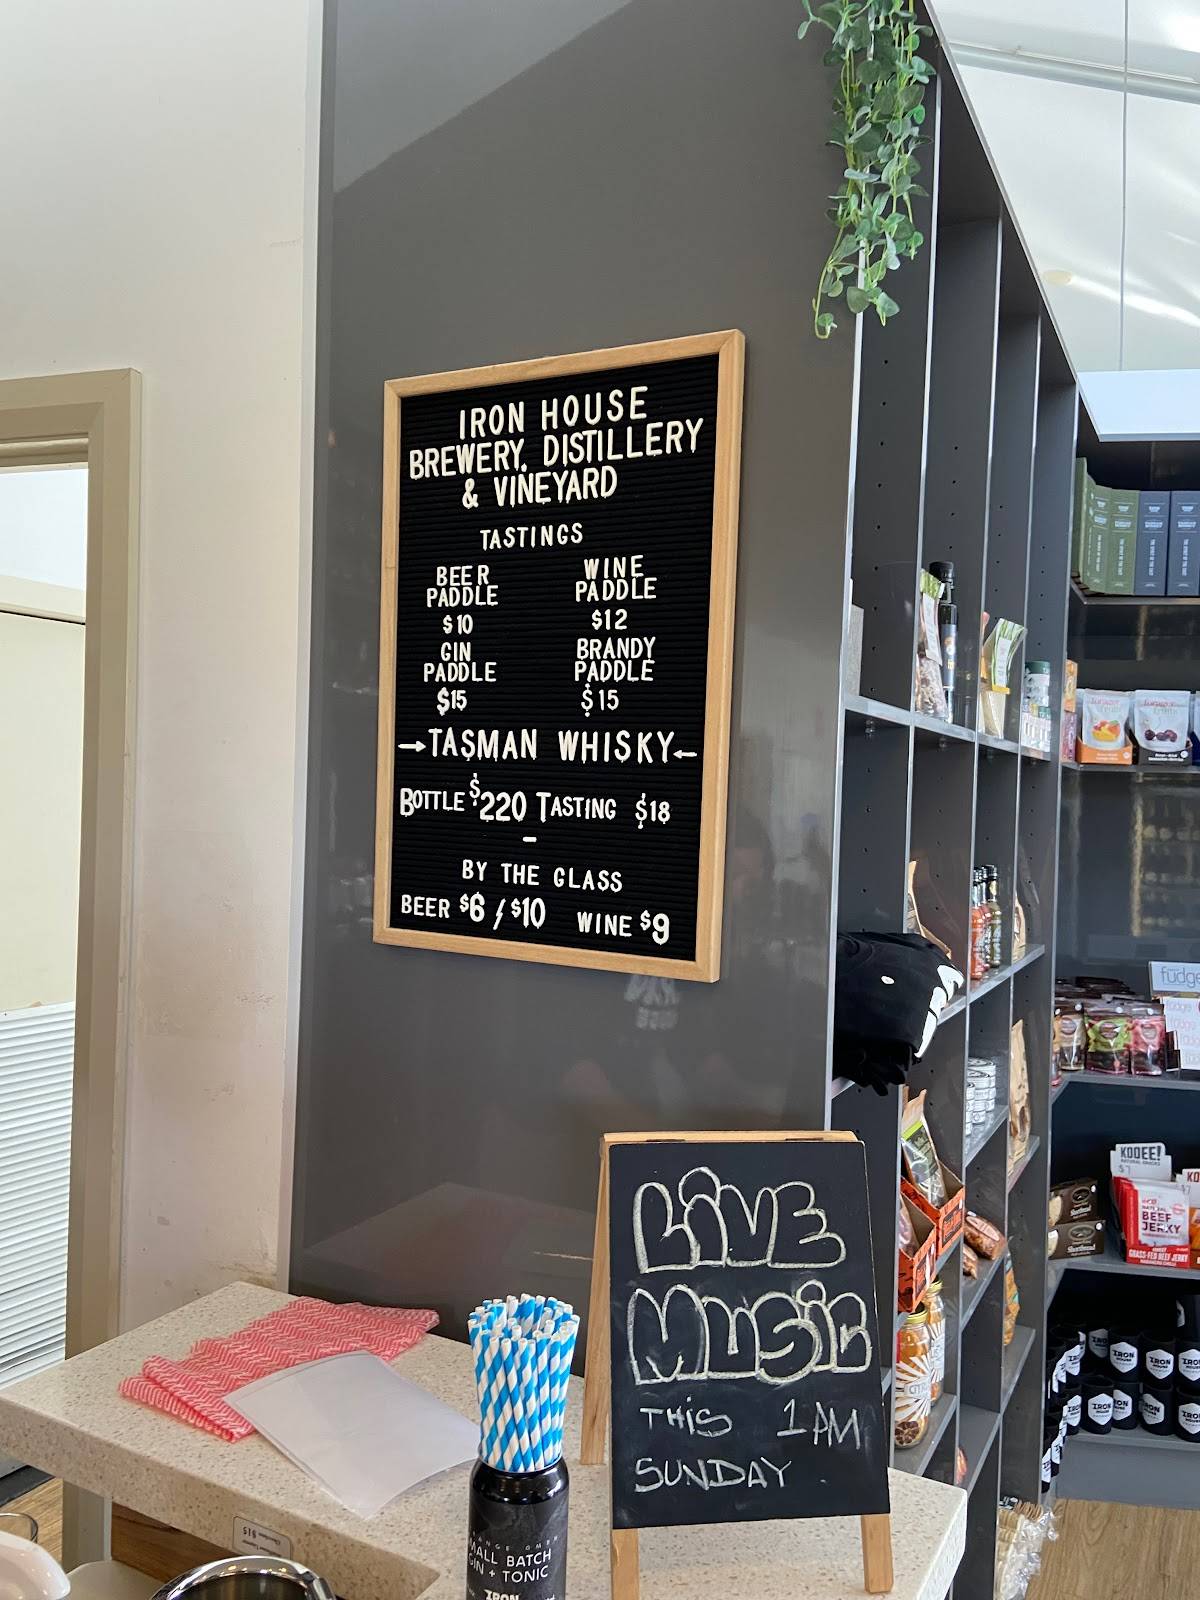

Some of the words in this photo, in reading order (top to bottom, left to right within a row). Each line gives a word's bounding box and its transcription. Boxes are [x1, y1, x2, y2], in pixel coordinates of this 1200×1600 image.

[459, 402, 526, 440] IRON
[541, 385, 649, 431] HOUSE
[543, 417, 704, 467] DISTILLERY
[461, 477, 479, 509] &
[494, 465, 618, 507] VINEYARD
[480, 522, 584, 550] TASTINGS
[436, 564, 490, 586] BEER
[583, 554, 645, 579] WINE
[426, 584, 499, 607] PADDLE
[575, 576, 657, 602] PADDLE
[442, 613, 474, 634] $10
[591, 608, 628, 630] $12
[440, 641, 472, 661] GIN
[576, 636, 656, 659] BRANDY
[423, 661, 498, 682] PADDLE
[574, 660, 656, 682] PADDLE
[436, 687, 468, 716] $15
[580, 683, 620, 717] $15
[428, 727, 537, 762] TASMAN
[558, 730, 674, 763] WHISKY
[400, 787, 465, 817] BOTTLE
[469, 772, 527, 822] $220
[535, 791, 617, 822] TASTING
[635, 793, 671, 829] $18
[462, 858, 487, 882] BY
[500, 862, 540, 886] THE
[553, 867, 622, 892] GLASS
[400, 893, 450, 919] BEER
[459, 891, 486, 923] $6
[577, 910, 632, 937] WINE
[640, 909, 670, 945] $9
[1142, 1211, 1172, 1222] BEEF
[1142, 1222, 1181, 1233] JERKY
[1112, 1350, 1135, 1359] IRON
[1150, 1357, 1171, 1365] IRON
[634, 1456, 792, 1492] SUNDAY
[468, 1552, 484, 1575] GIN
[502, 1565, 549, 1583] TONIC
[506, 1548, 552, 1568] BATCH
